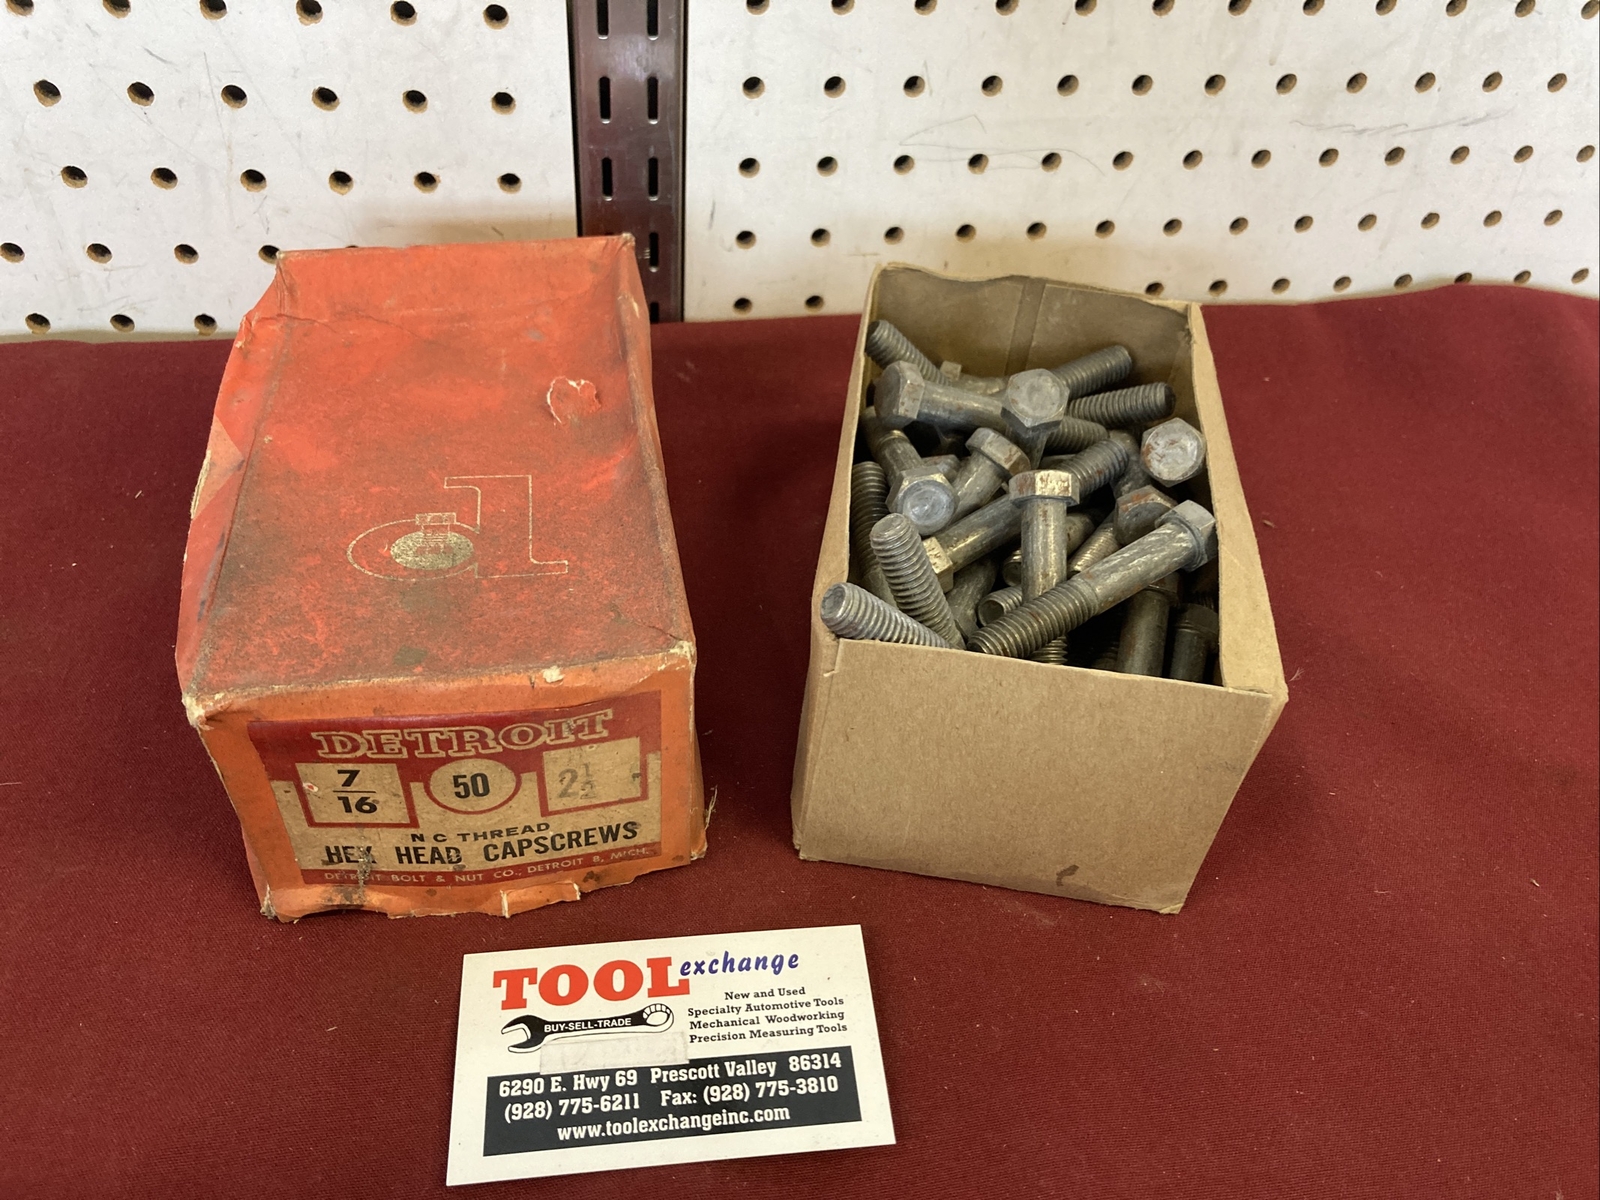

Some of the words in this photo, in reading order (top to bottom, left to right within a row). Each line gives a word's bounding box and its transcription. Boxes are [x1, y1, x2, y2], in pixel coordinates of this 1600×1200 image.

[311, 709, 613, 759] DETROIT
[337, 769, 361, 787] 7
[452, 772, 491, 799] 50
[337, 796, 377, 813] 16
[325, 845, 377, 864] HEX
[394, 846, 463, 865] HEAD
[483, 821, 638, 862] CAPSCREWS
[456, 822, 550, 842] THREAD
[390, 874, 425, 883] BOLT
[435, 875, 446, 883] &
[455, 873, 484, 882] NUT
[527, 857, 584, 874] DETROIT
[610, 847, 650, 861] MICH.
[493, 956, 690, 1010] TOOL
[680, 950, 800, 977] exchange
[724, 991, 751, 1001] New
[753, 989, 775, 999] and
[777, 987, 806, 997] Used
[687, 1005, 742, 1018] Specialty
[744, 999, 812, 1013] Automotive
[813, 997, 845, 1007] Tools
[543, 1017, 632, 1033] BUY-SELL-TRADE
[689, 1016, 761, 1030] Mechanical
[764, 1010, 845, 1024] Woodworking
[689, 1031, 747, 1044] Precision
[749, 1026, 814, 1039] Measuring
[816, 1023, 848, 1034] Tools
[499, 1077, 545, 1098] 6290
[550, 1076, 567, 1093] E.
[573, 1074, 610, 1092] Hwy
[615, 1069, 638, 1087] 69
[650, 1063, 720, 1084] Prescott
[724, 1059, 777, 1078] Valley
[788, 1052, 842, 1072] 86314
[504, 1100, 553, 1124] (928)
[558, 1092, 640, 1116] 775-6211
[660, 1090, 697, 1107] Fax:
[703, 1083, 750, 1106] (928)
[755, 1075, 839, 1098] 775-3810
[557, 1106, 791, 1141] www.toolexchangeinc.com
